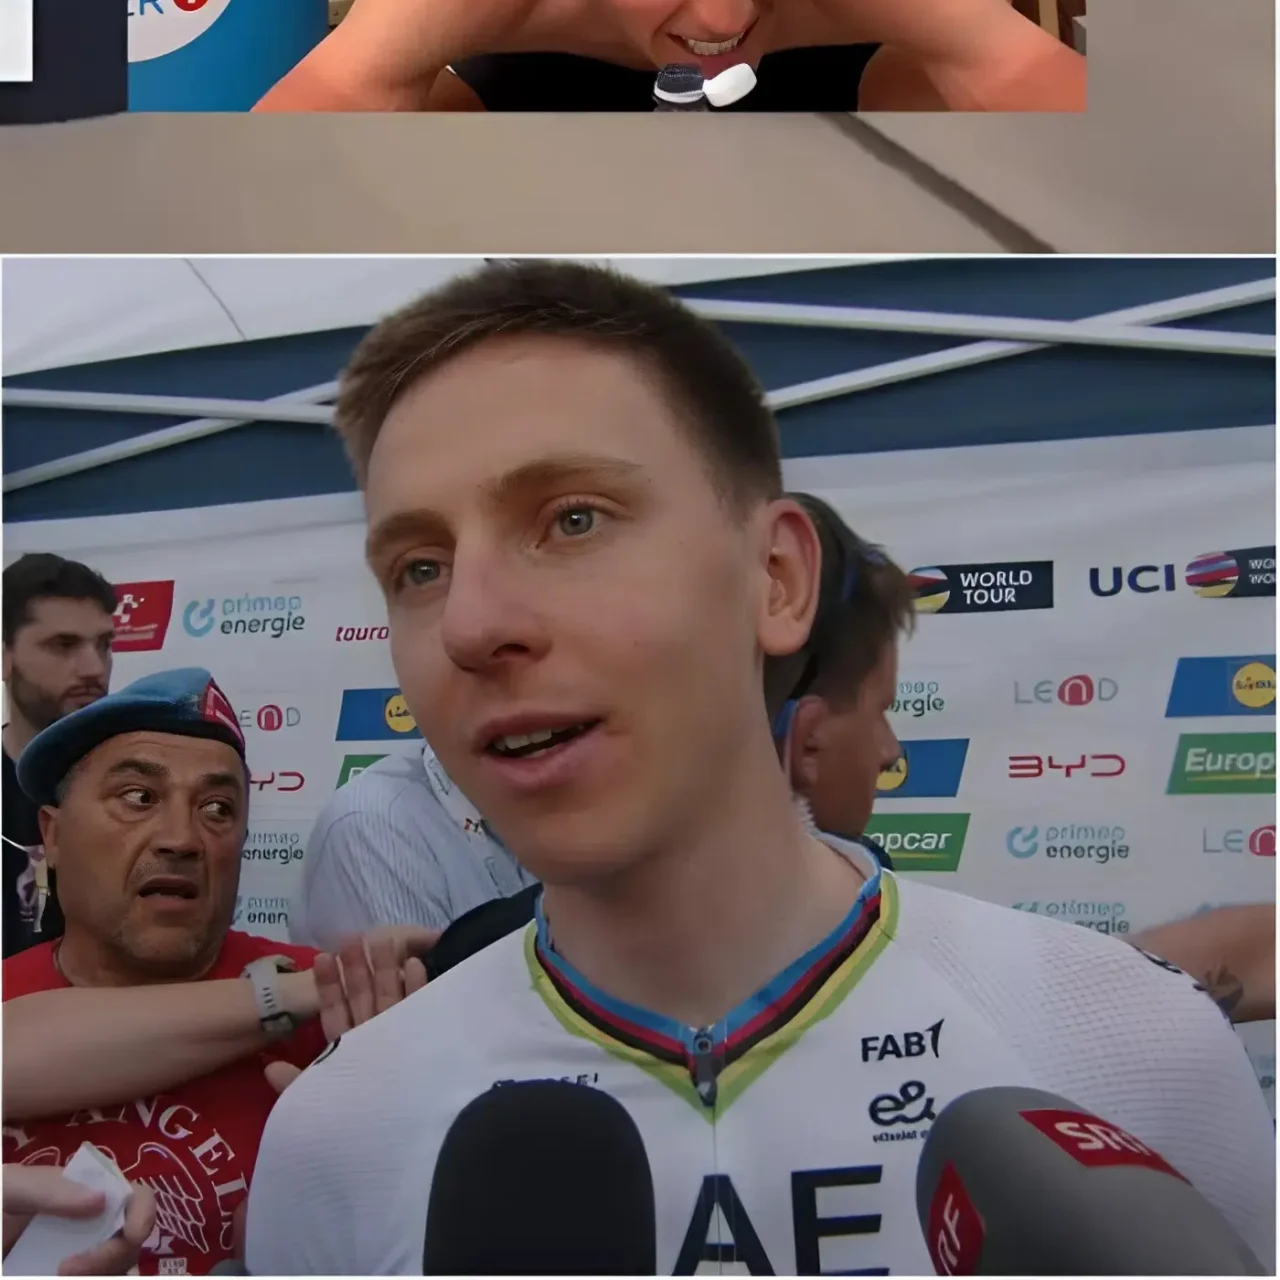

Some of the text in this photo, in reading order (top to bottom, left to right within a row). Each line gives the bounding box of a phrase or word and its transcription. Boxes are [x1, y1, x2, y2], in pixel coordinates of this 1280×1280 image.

[959, 568, 1033, 588] WORLD
[1088, 563, 1176, 597] UCI
[221, 593, 302, 616] primeo
[962, 587, 1016, 605] TOUR
[220, 611, 306, 639] energie
[1008, 753, 1126, 778] BYD
[1045, 840, 1130, 864] energie
